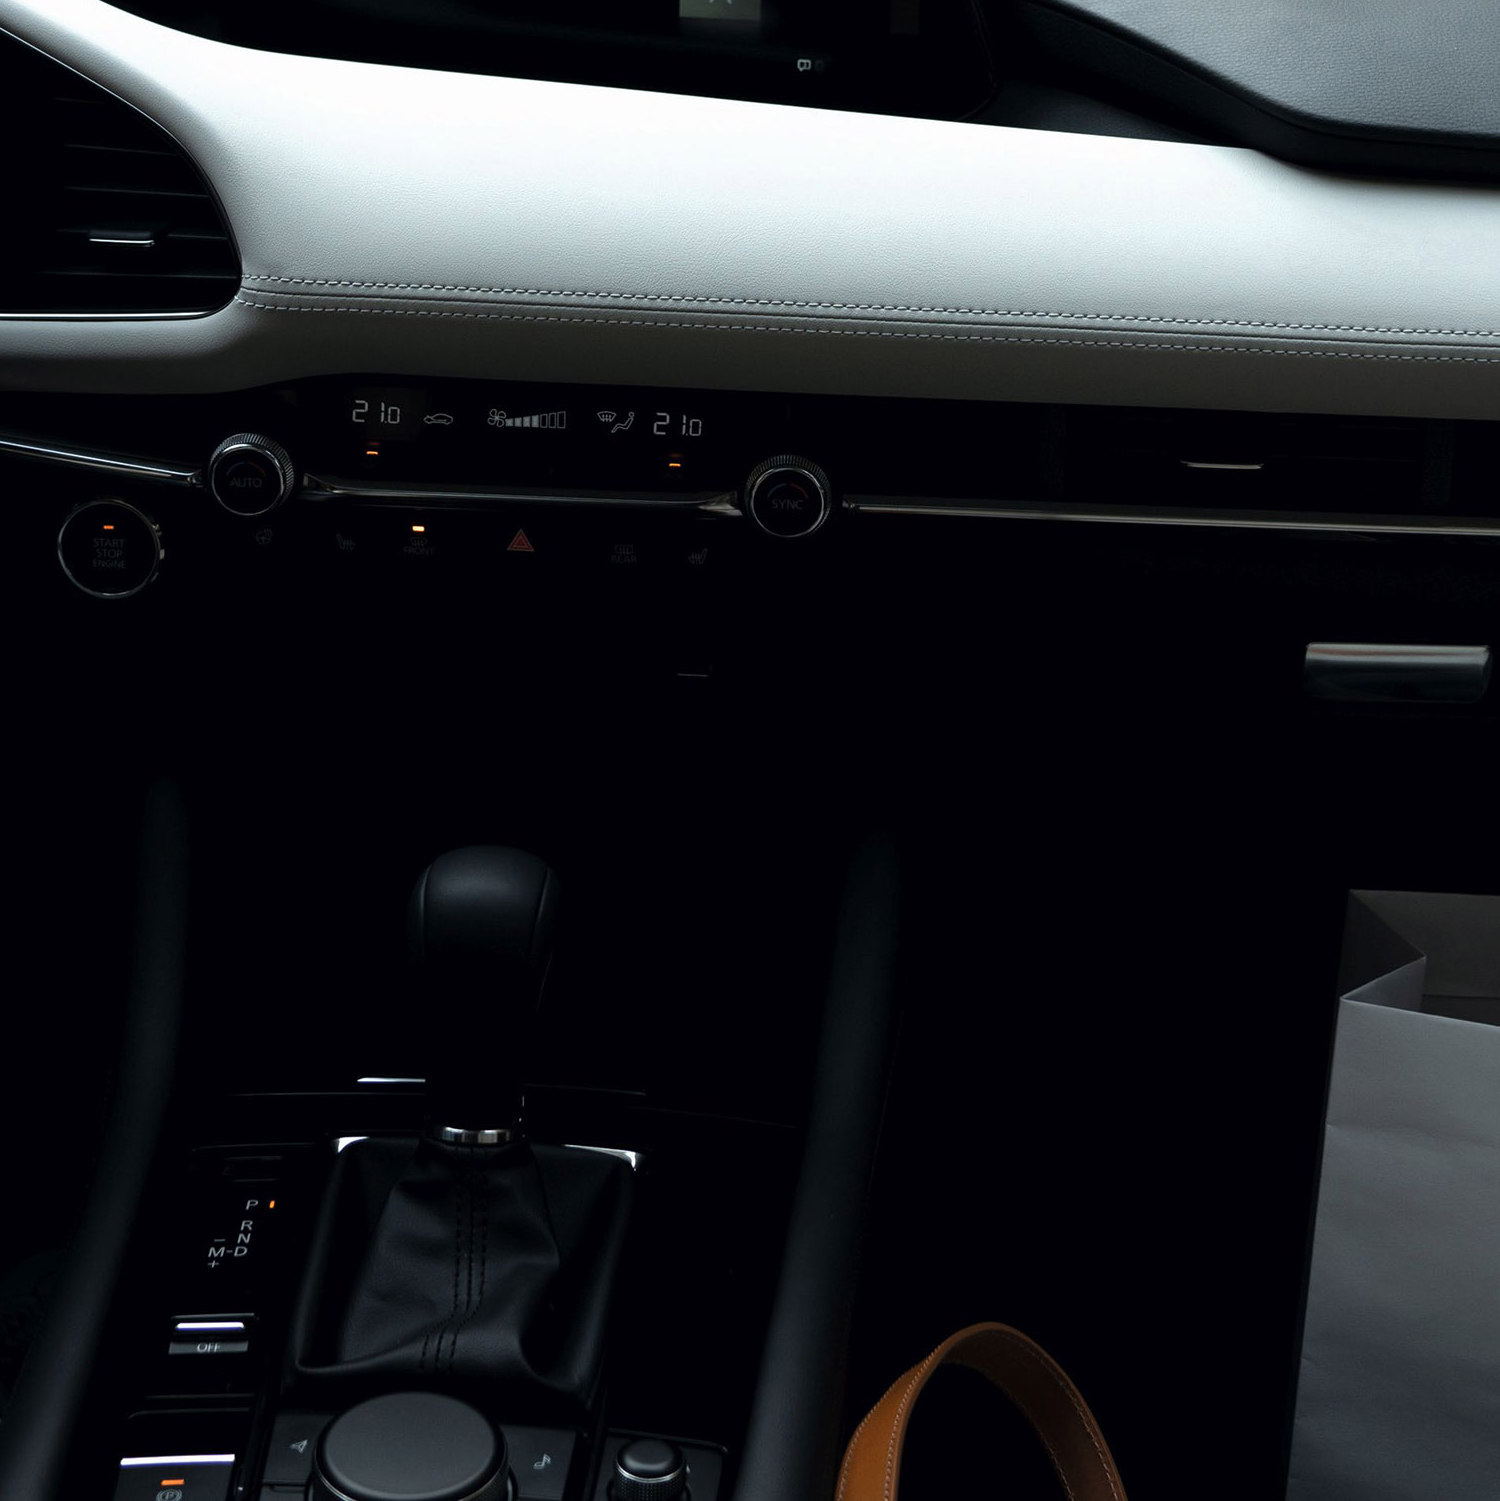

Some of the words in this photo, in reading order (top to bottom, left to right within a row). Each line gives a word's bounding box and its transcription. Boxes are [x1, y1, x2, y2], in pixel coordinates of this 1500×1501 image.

[228, 477, 264, 489] AUTO
[771, 499, 804, 510] SYNC
[92, 537, 125, 549] START
[95, 548, 124, 559] STOP
[403, 545, 436, 557] FRONT
[92, 558, 126, 570] ENGINE
[245, 1199, 260, 1212] P
[240, 1220, 254, 1232] R
[236, 1232, 252, 1245] N
